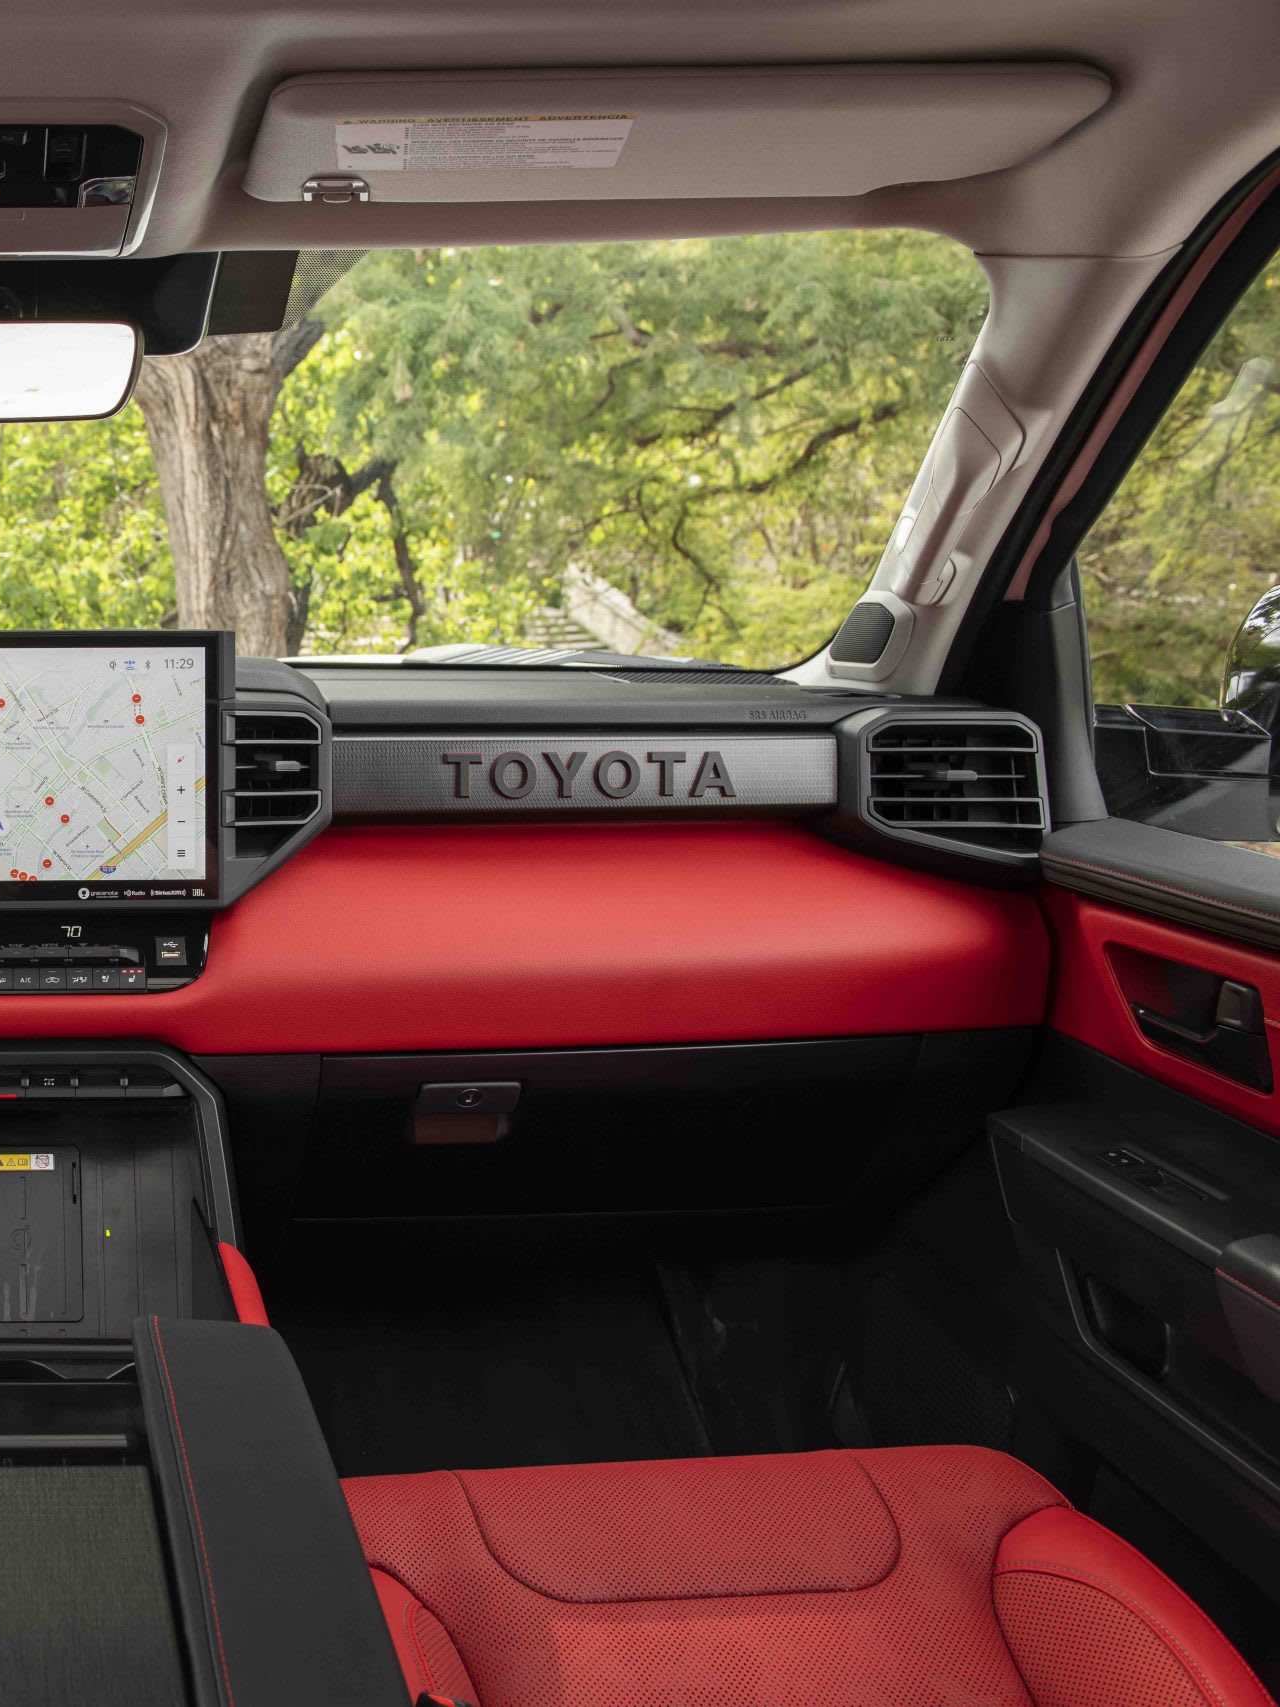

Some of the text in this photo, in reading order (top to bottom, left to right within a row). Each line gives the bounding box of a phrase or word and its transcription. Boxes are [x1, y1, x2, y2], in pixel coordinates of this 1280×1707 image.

[163, 658, 195, 669] 11:29
[748, 710, 766, 720] SRS
[442, 750, 736, 799] TOYOTA
[191, 888, 205, 897] JBL
[60, 925, 82, 938] 70
